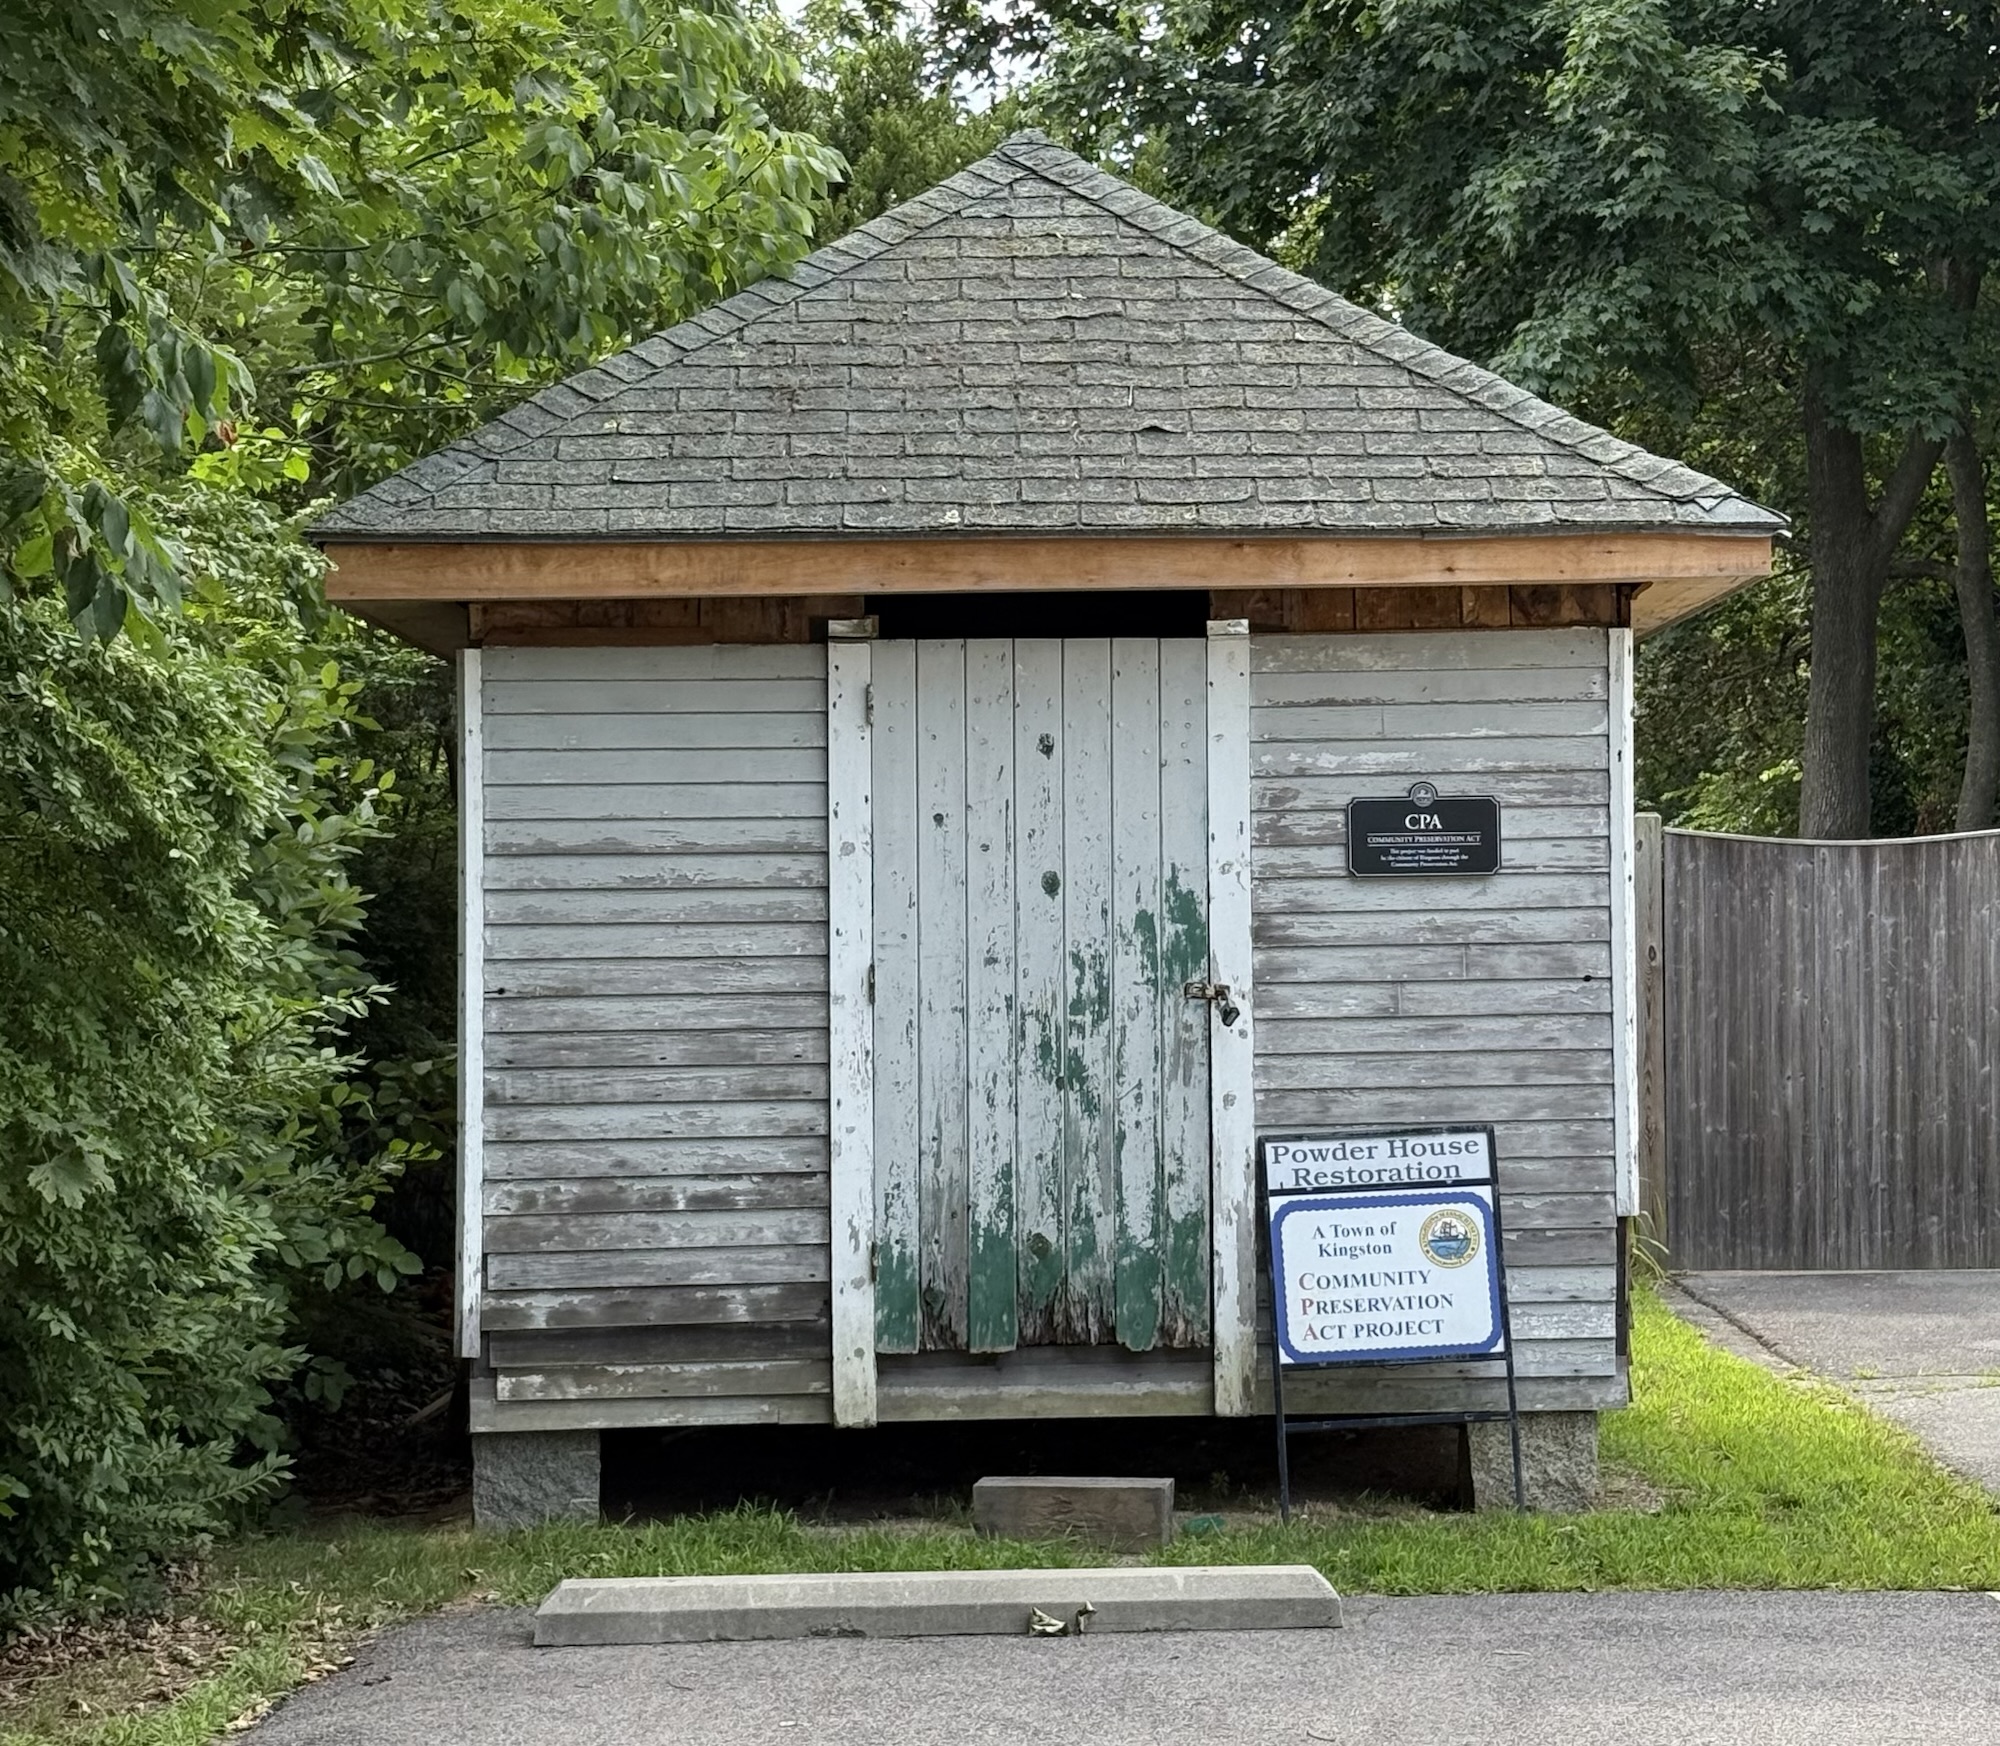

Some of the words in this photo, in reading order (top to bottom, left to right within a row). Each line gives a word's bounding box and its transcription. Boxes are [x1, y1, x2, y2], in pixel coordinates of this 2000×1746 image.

[1404, 813, 1443, 829] CPA
[1271, 1142, 1379, 1164] Powder
[1387, 1139, 1480, 1159] House
[1291, 1161, 1462, 1187] Restoration
[1312, 1225, 1326, 1240] A
[1329, 1223, 1375, 1238] Town
[1380, 1221, 1397, 1236] of
[1318, 1242, 1393, 1260] Kingston
[1298, 1269, 1432, 1291] COMMUNITY
[1301, 1293, 1454, 1316] PRESERVATION
[1302, 1323, 1347, 1341] ACT
[1353, 1319, 1445, 1338] PROJECT
